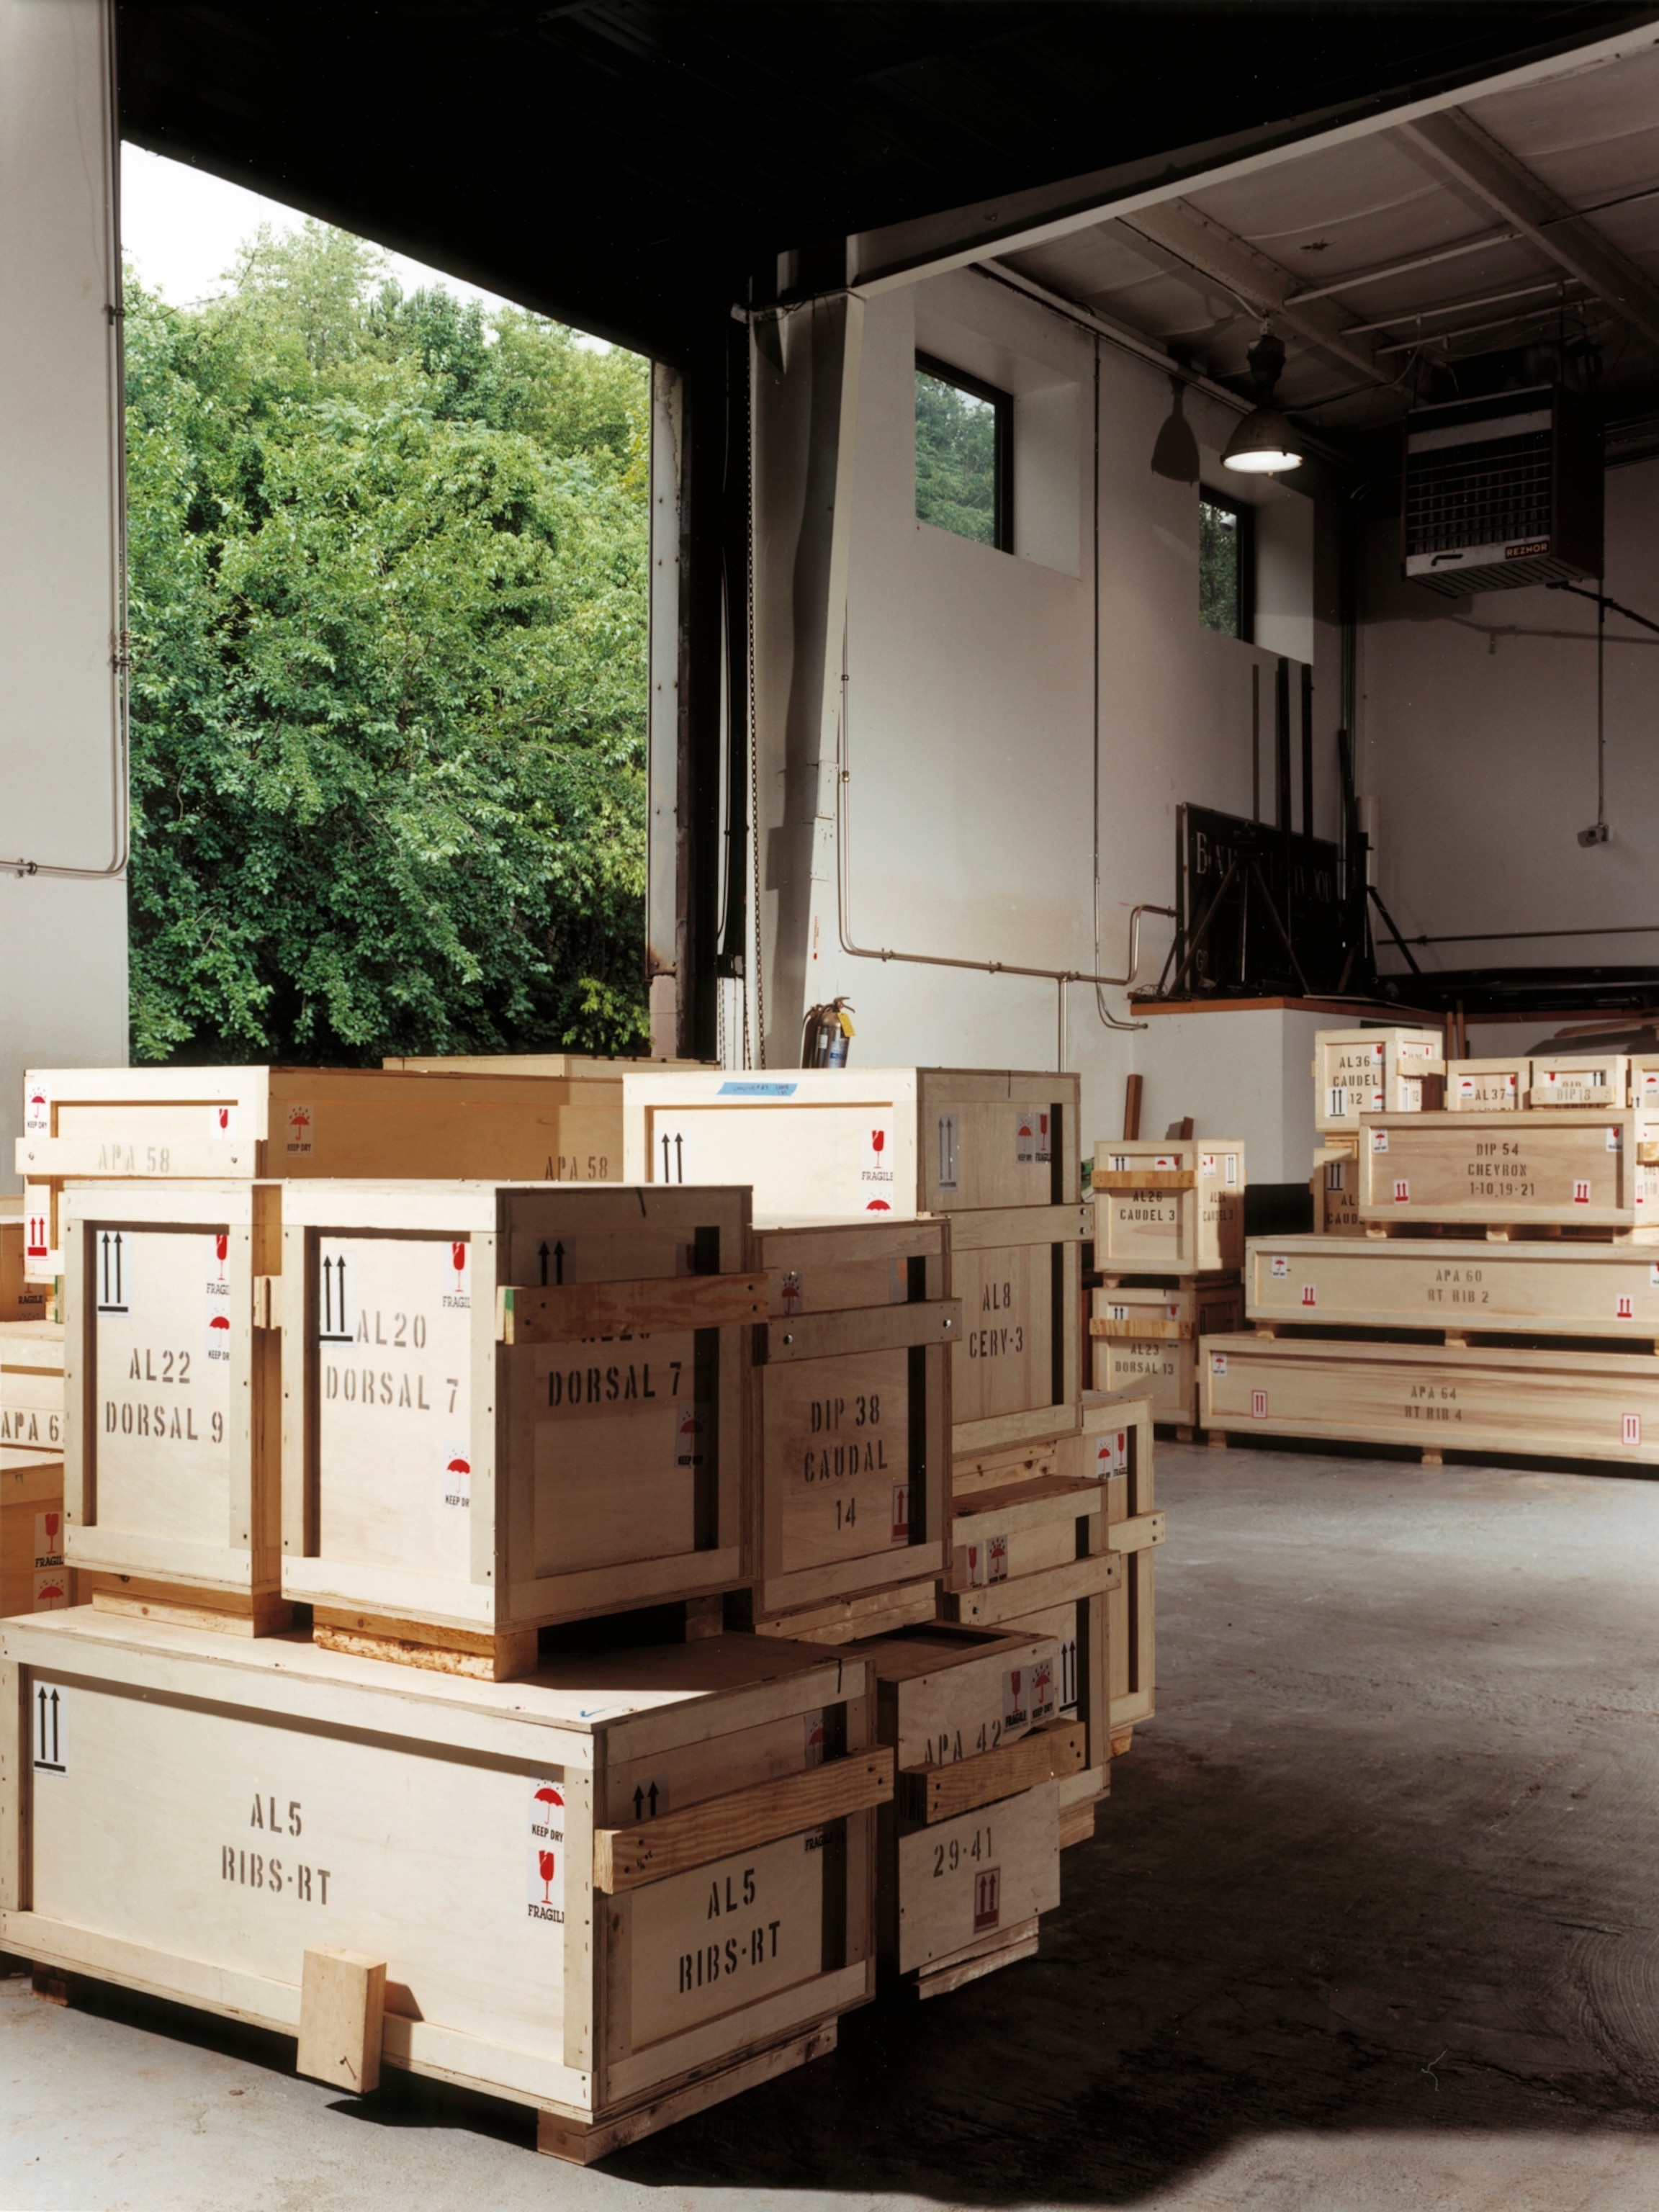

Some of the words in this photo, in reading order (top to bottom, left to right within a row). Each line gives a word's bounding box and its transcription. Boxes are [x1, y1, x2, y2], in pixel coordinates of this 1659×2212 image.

[1506, 543, 1547, 557] REZNOR
[1339, 1056, 1370, 1069] AL36
[1333, 1074, 1379, 1087] CAUDEL
[1349, 1093, 1362, 1105] 12
[1475, 1089, 1506, 1100] AL37
[1477, 1143, 1496, 1156] DIP
[1503, 1143, 1519, 1156] 54
[99, 1145, 135, 1172] APA
[147, 1146, 170, 1173] 58
[545, 1156, 578, 1180] APA
[588, 1156, 608, 1179] 58
[1468, 1164, 1527, 1177] CHEVRON
[1133, 1191, 1162, 1202] AL26
[1341, 1195, 1359, 1206] AL
[1120, 1209, 1164, 1221] CAUDEL
[1169, 1210, 1175, 1221] 3
[1326, 1213, 1365, 1224] CAUD
[1436, 1269, 1460, 1282] APA
[1467, 1270, 1482, 1282] 60
[983, 1282, 1011, 1311] AL8
[1428, 1290, 1443, 1301] RT
[1452, 1290, 1475, 1303] RIB
[1482, 1291, 1488, 1303] 2
[357, 1309, 426, 1349] AL20
[209, 1350, 221, 1359] KEEP
[1130, 1344, 1159, 1356] AL23
[130, 1348, 191, 1383] AL22
[1115, 1361, 1158, 1375] DORSAL
[1162, 1364, 1174, 1375] 13
[327, 1366, 430, 1411] DORSAL
[446, 1378, 458, 1413] 7
[549, 1363, 655, 1406] DORSAL
[670, 1362, 682, 1396] 7
[1411, 1386, 1434, 1399] APA
[1442, 1388, 1457, 1400] 64
[811, 1398, 845, 1433] DIP
[855, 1395, 880, 1426] 38
[1405, 1406, 1420, 1418] RT
[1426, 1407, 1449, 1420] RIB
[1455, 1409, 1462, 1421] 4
[1, 1411, 38, 1440] APA
[106, 1401, 198, 1441] DORSAL
[212, 1411, 223, 1443] 9
[804, 1439, 887, 1483] CAUDAL
[445, 1495, 460, 1506] KEEP
[462, 1497, 470, 1509] DR
[836, 1498, 856, 1530] 14
[35, 1555, 63, 1568] FRAGIL
[1033, 1707, 1043, 1719] KEEP
[1044, 1702, 1053, 1713] DRY
[1005, 1709, 1027, 1727] FRAGILE
[925, 1730, 963, 1765] APA
[976, 1719, 1002, 1752] 42
[251, 1793, 302, 1836] AL5
[531, 1824, 549, 1838] KEEP
[550, 1829, 564, 1843] DRY
[708, 1869, 755, 1920] AL5
